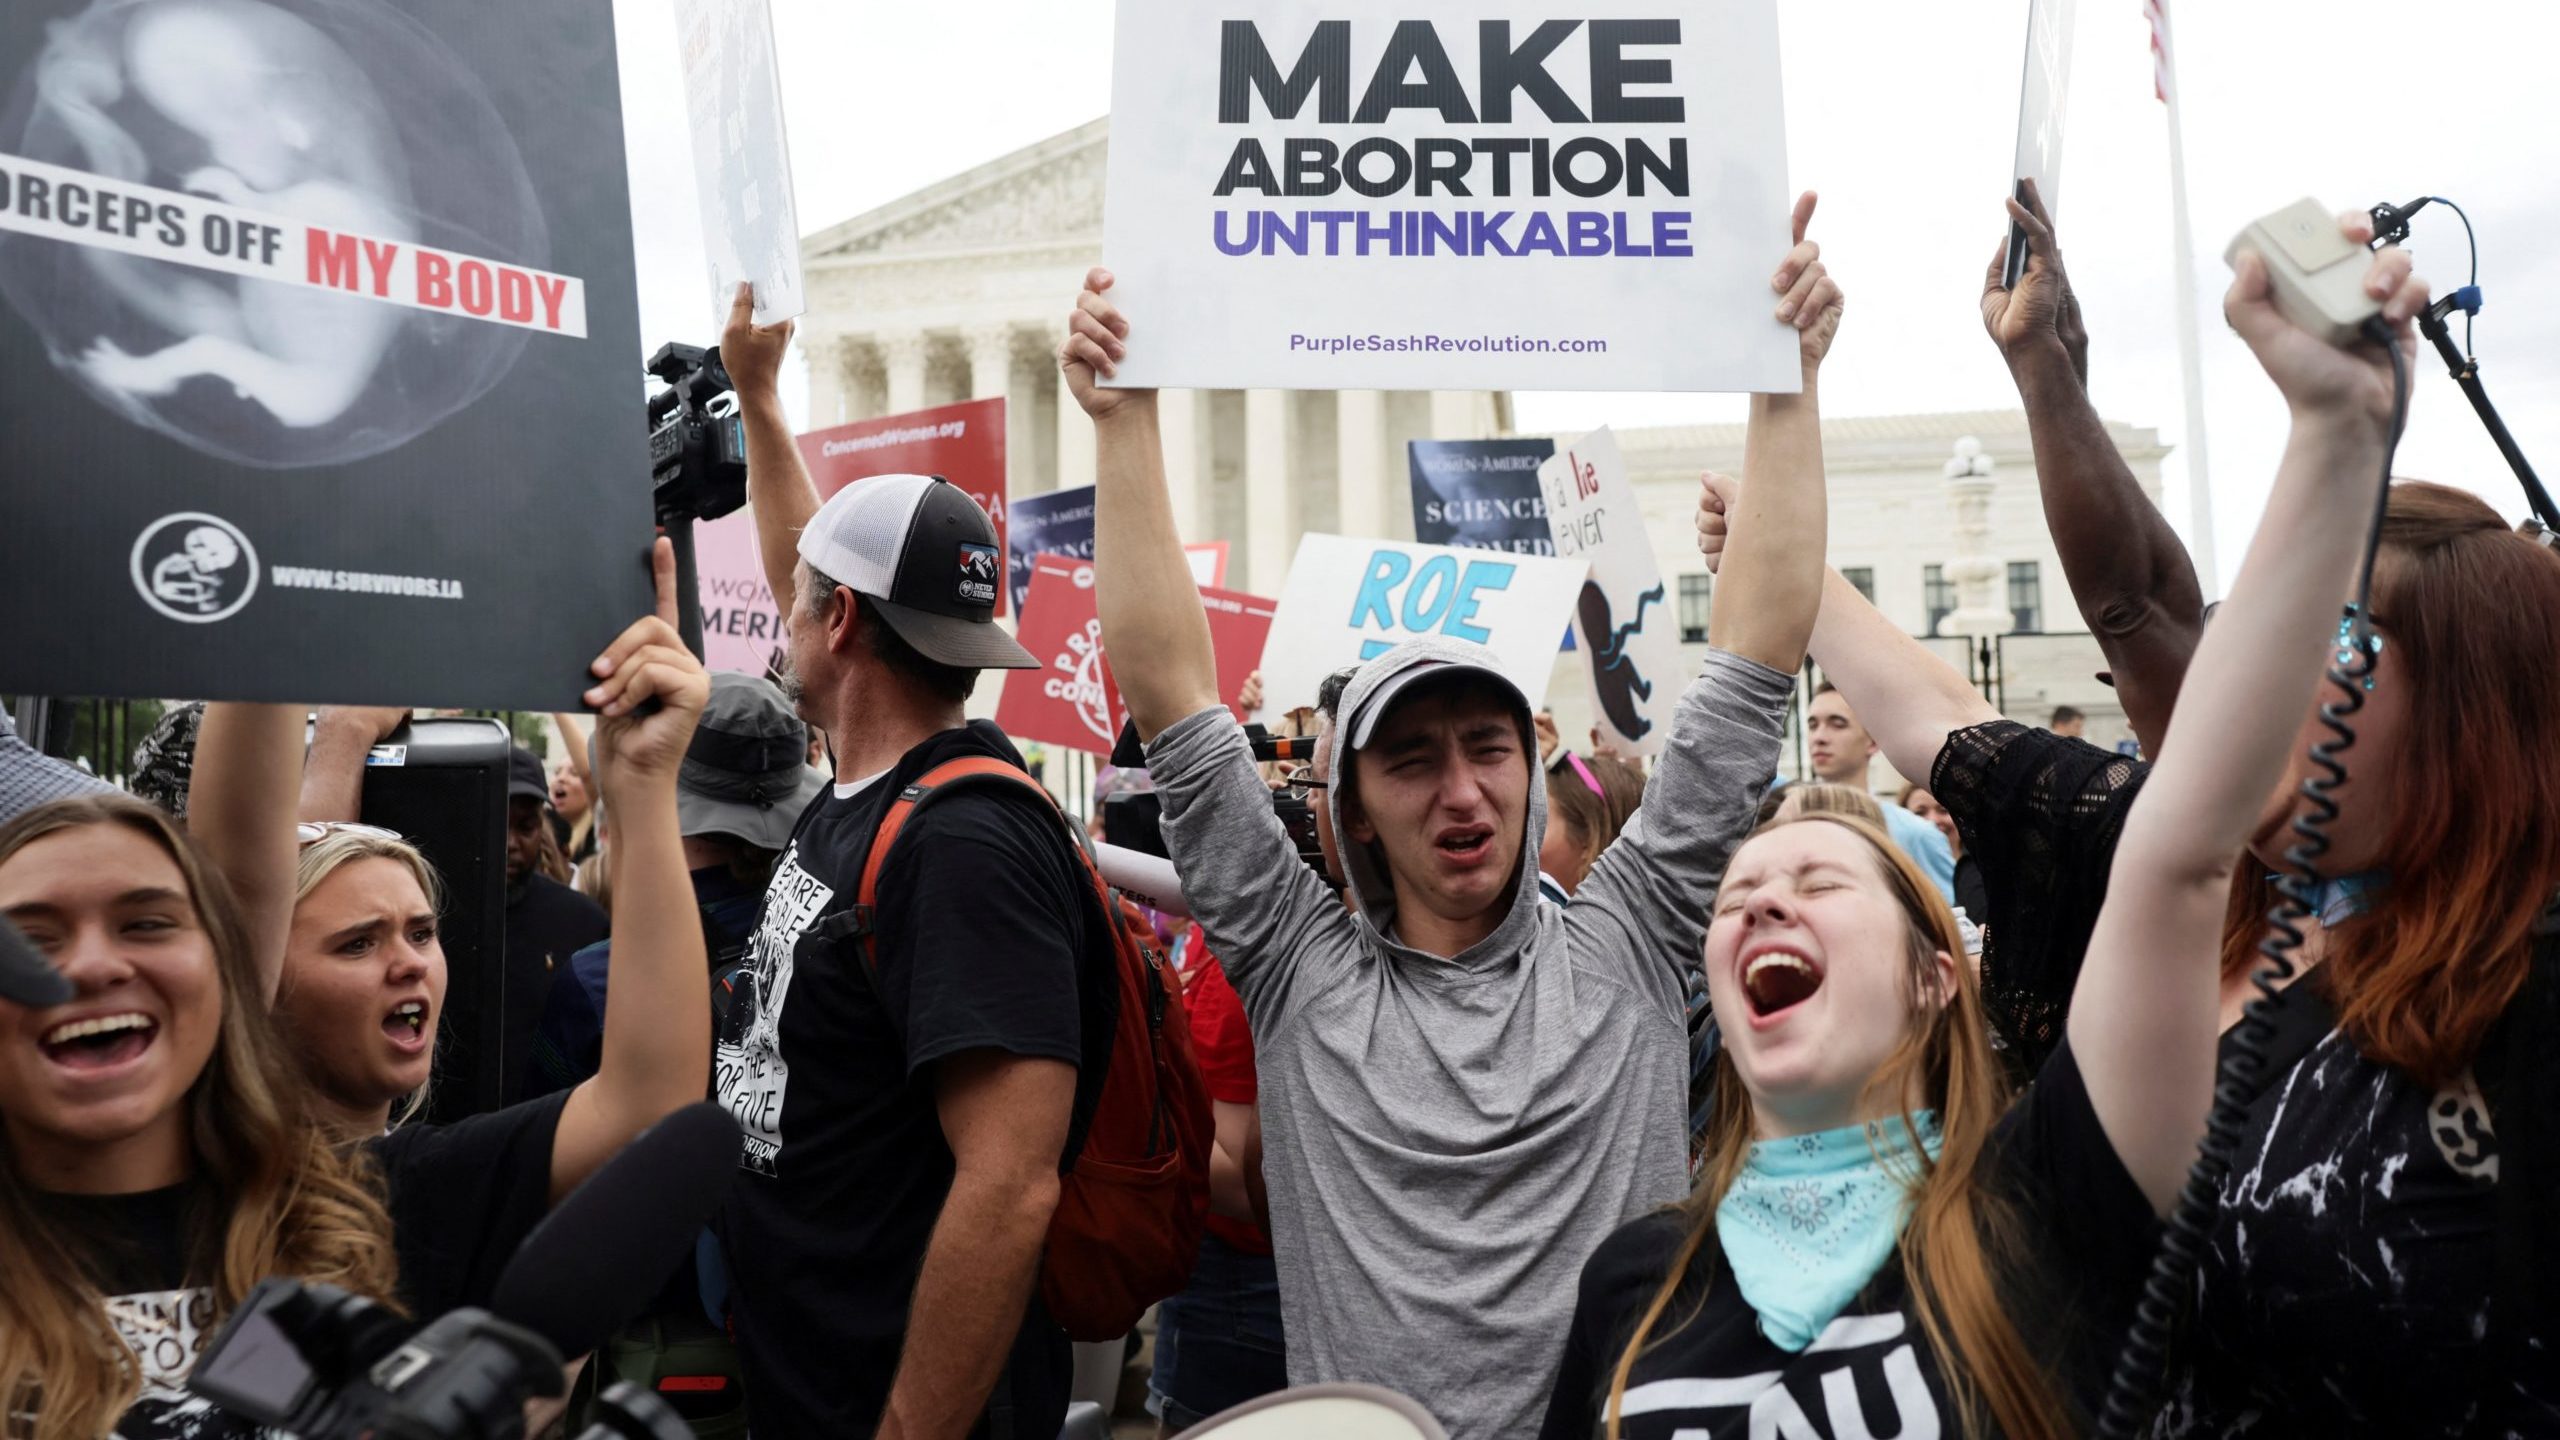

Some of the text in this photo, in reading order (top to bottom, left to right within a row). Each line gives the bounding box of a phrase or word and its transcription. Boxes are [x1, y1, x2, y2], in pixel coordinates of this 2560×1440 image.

[1218, 18, 1686, 124] MAKE
[1212, 136, 1690, 198] ABORTION
[1213, 210, 1694, 257] UNTHINKABLE
[202, 213, 281, 266] OFF
[305, 227, 399, 297] MY
[415, 250, 567, 329] BODY
[1290, 334, 1607, 355] PurpleSashRevolution.com
[822, 420, 965, 457] ConcernedWomen.org
[1569, 450, 1600, 502] lie
[1425, 497, 1548, 524] SCIENCE
[272, 565, 464, 600] WWW.SURVIVORS.LA
[1349, 550, 1517, 645] ROE
[1107, 882, 1157, 907] TERS
[717, 1052, 766, 1099] OR THE
[732, 1090, 776, 1134] FIVE
